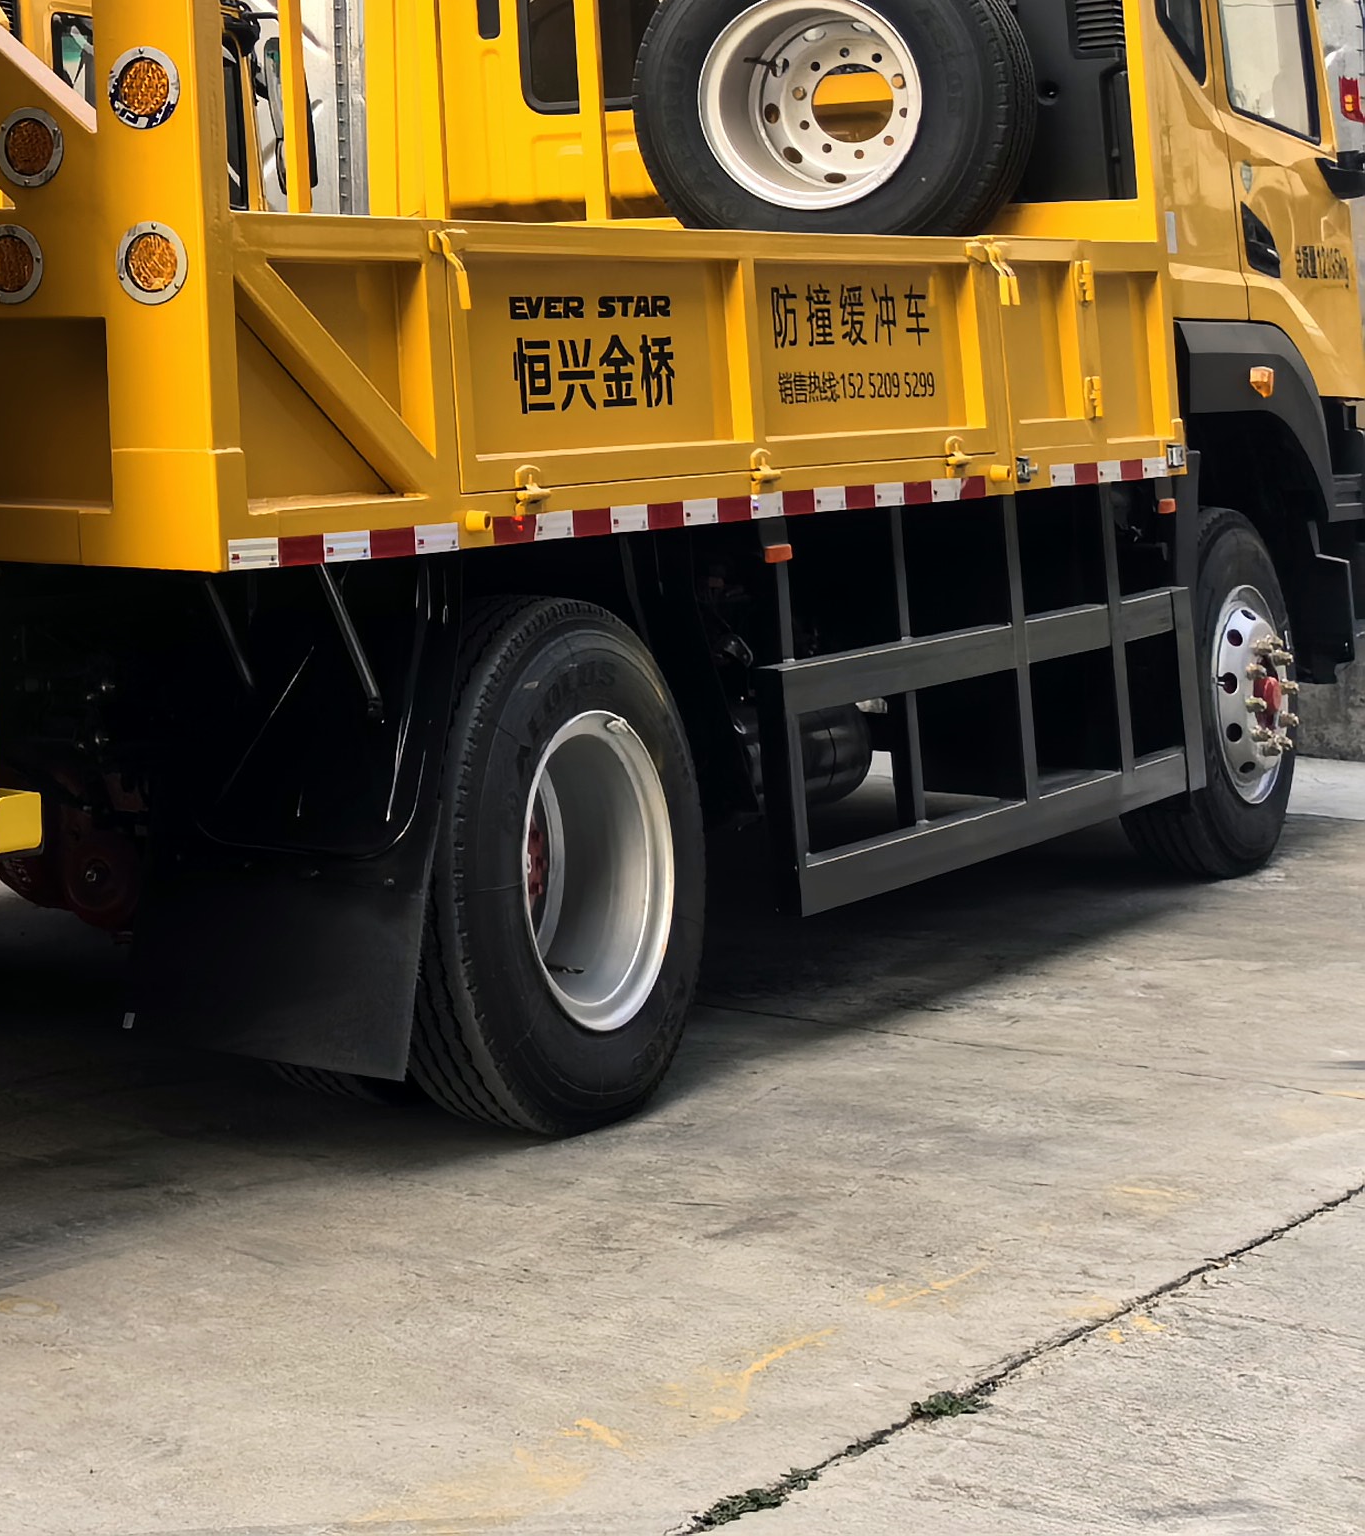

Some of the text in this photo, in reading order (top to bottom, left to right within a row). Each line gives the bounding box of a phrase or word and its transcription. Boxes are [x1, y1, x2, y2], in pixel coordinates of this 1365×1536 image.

[509, 294, 671, 321] EVER STAR
[770, 283, 930, 350] 防撞缓冲车
[513, 334, 675, 415] 恒兴金桥
[869, 372, 900, 398] 5209
[904, 372, 935, 398] 5299
